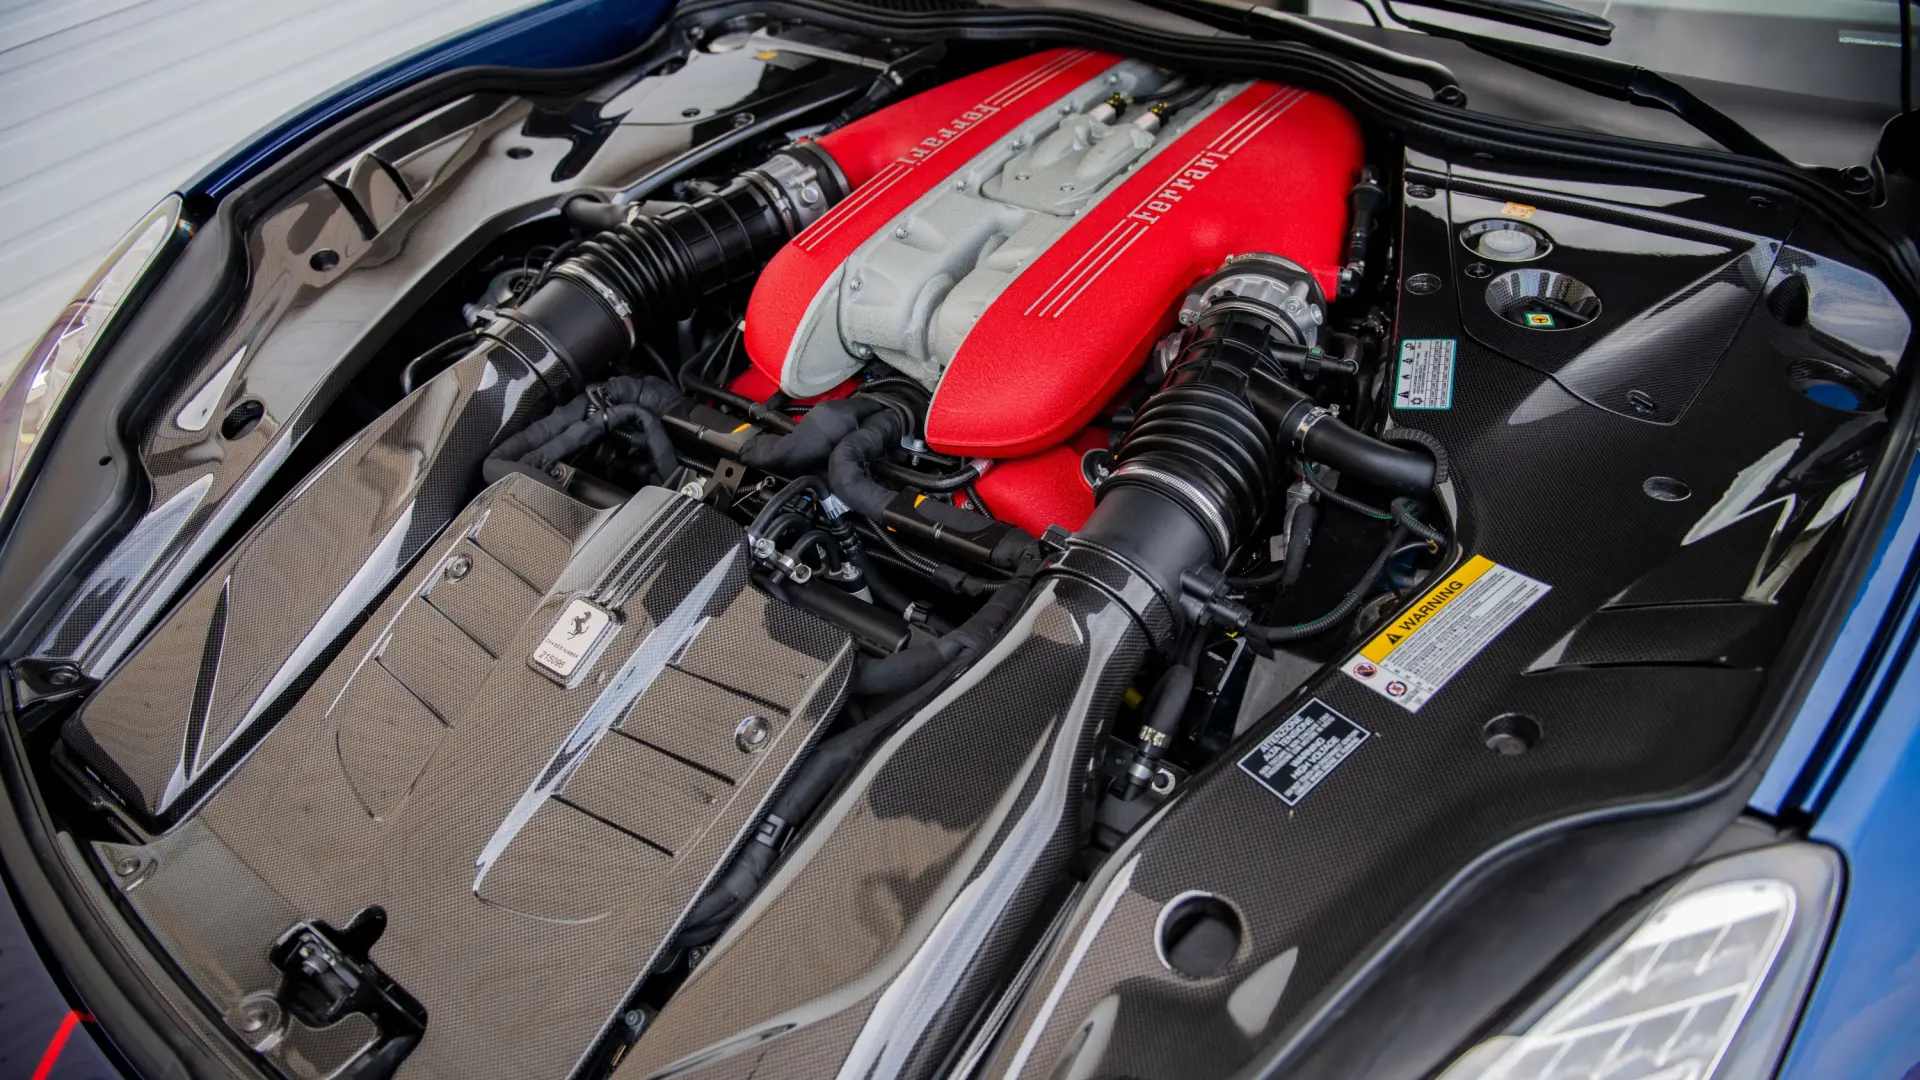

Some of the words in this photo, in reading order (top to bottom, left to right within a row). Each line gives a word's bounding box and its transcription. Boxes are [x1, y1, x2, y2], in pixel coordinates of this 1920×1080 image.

[896, 102, 1001, 165] Ferrari
[1128, 150, 1228, 224] Ferrari
[1399, 580, 1463, 628] WARNING
[538, 650, 565, 669] 215096
[1289, 735, 1325, 767] WARNING
[1290, 760, 1311, 779] HIGH
[1307, 734, 1340, 762] VOLTAGE
